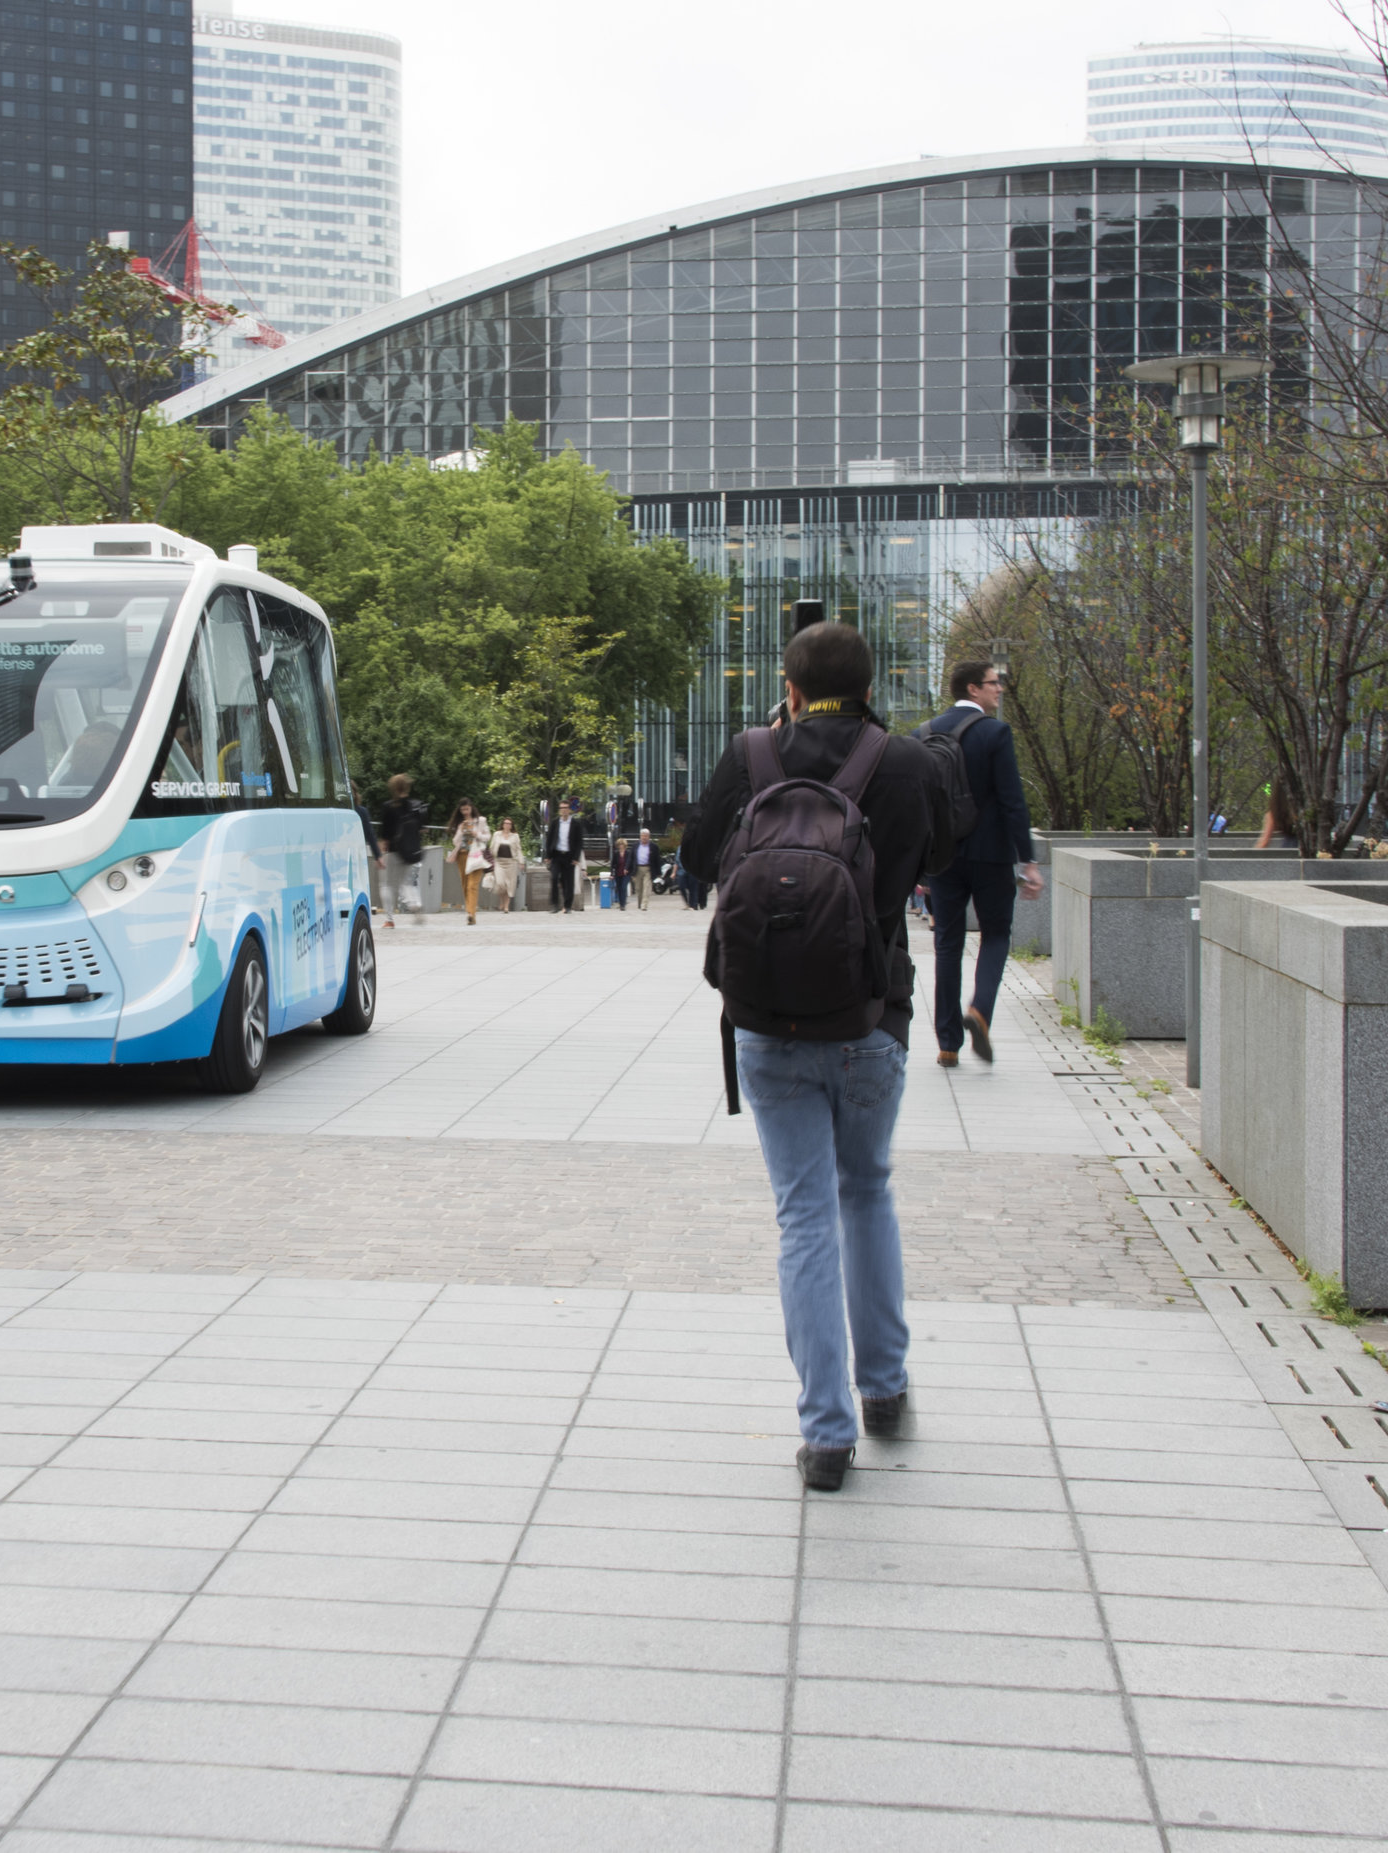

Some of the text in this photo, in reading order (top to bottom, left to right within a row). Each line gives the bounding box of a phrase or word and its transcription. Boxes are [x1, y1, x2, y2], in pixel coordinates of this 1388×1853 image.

[24, 643, 105, 655] autonome
[808, 700, 842, 713] Nikon
[151, 781, 205, 796] SERVICE
[206, 782, 240, 796] GRATUIT
